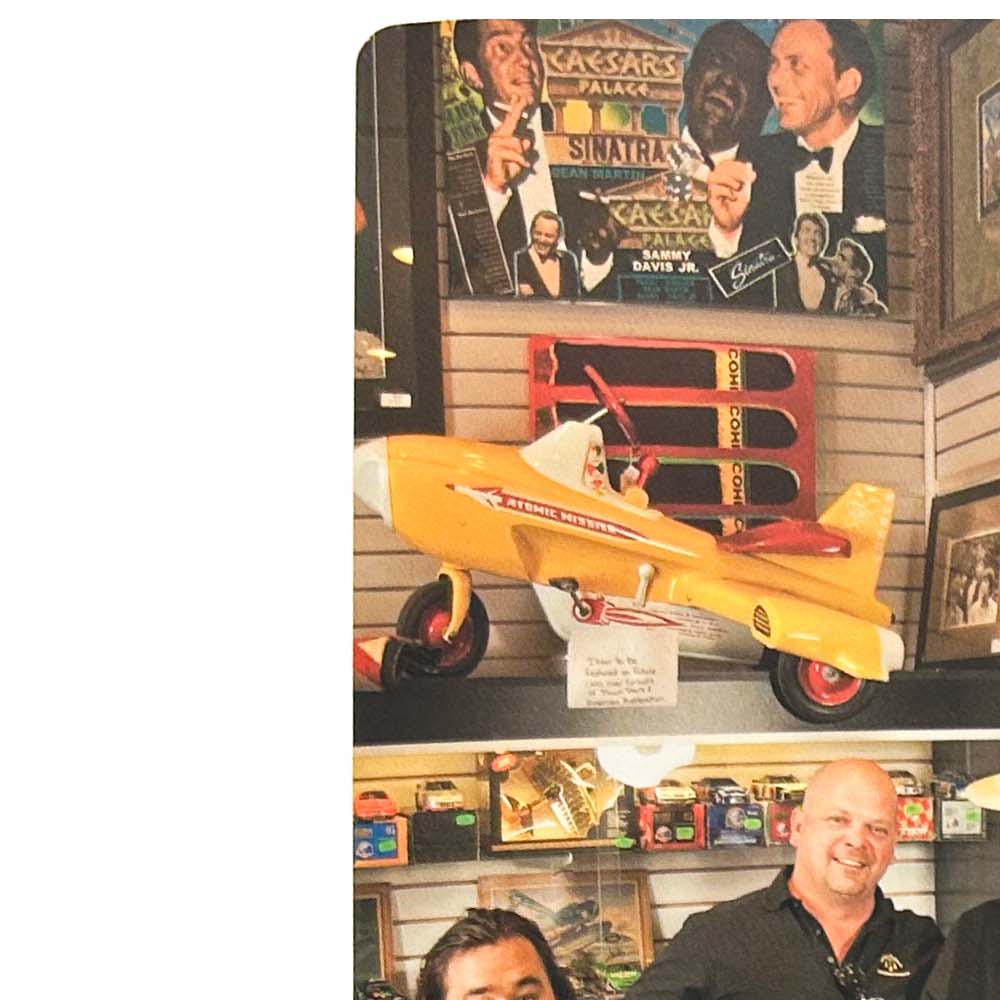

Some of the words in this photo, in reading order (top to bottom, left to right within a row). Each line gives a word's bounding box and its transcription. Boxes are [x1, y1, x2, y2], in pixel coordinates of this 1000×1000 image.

[549, 48, 677, 78] CAESARS
[578, 79, 650, 97] PALACE
[568, 136, 667, 164] SINATRA
[550, 166, 589, 179] DEAN
[642, 249, 691, 261] SAMMY
[632, 261, 674, 272] DAVIS
[678, 261, 700, 273] JR.
[506, 498, 558, 520] ATOMIC
